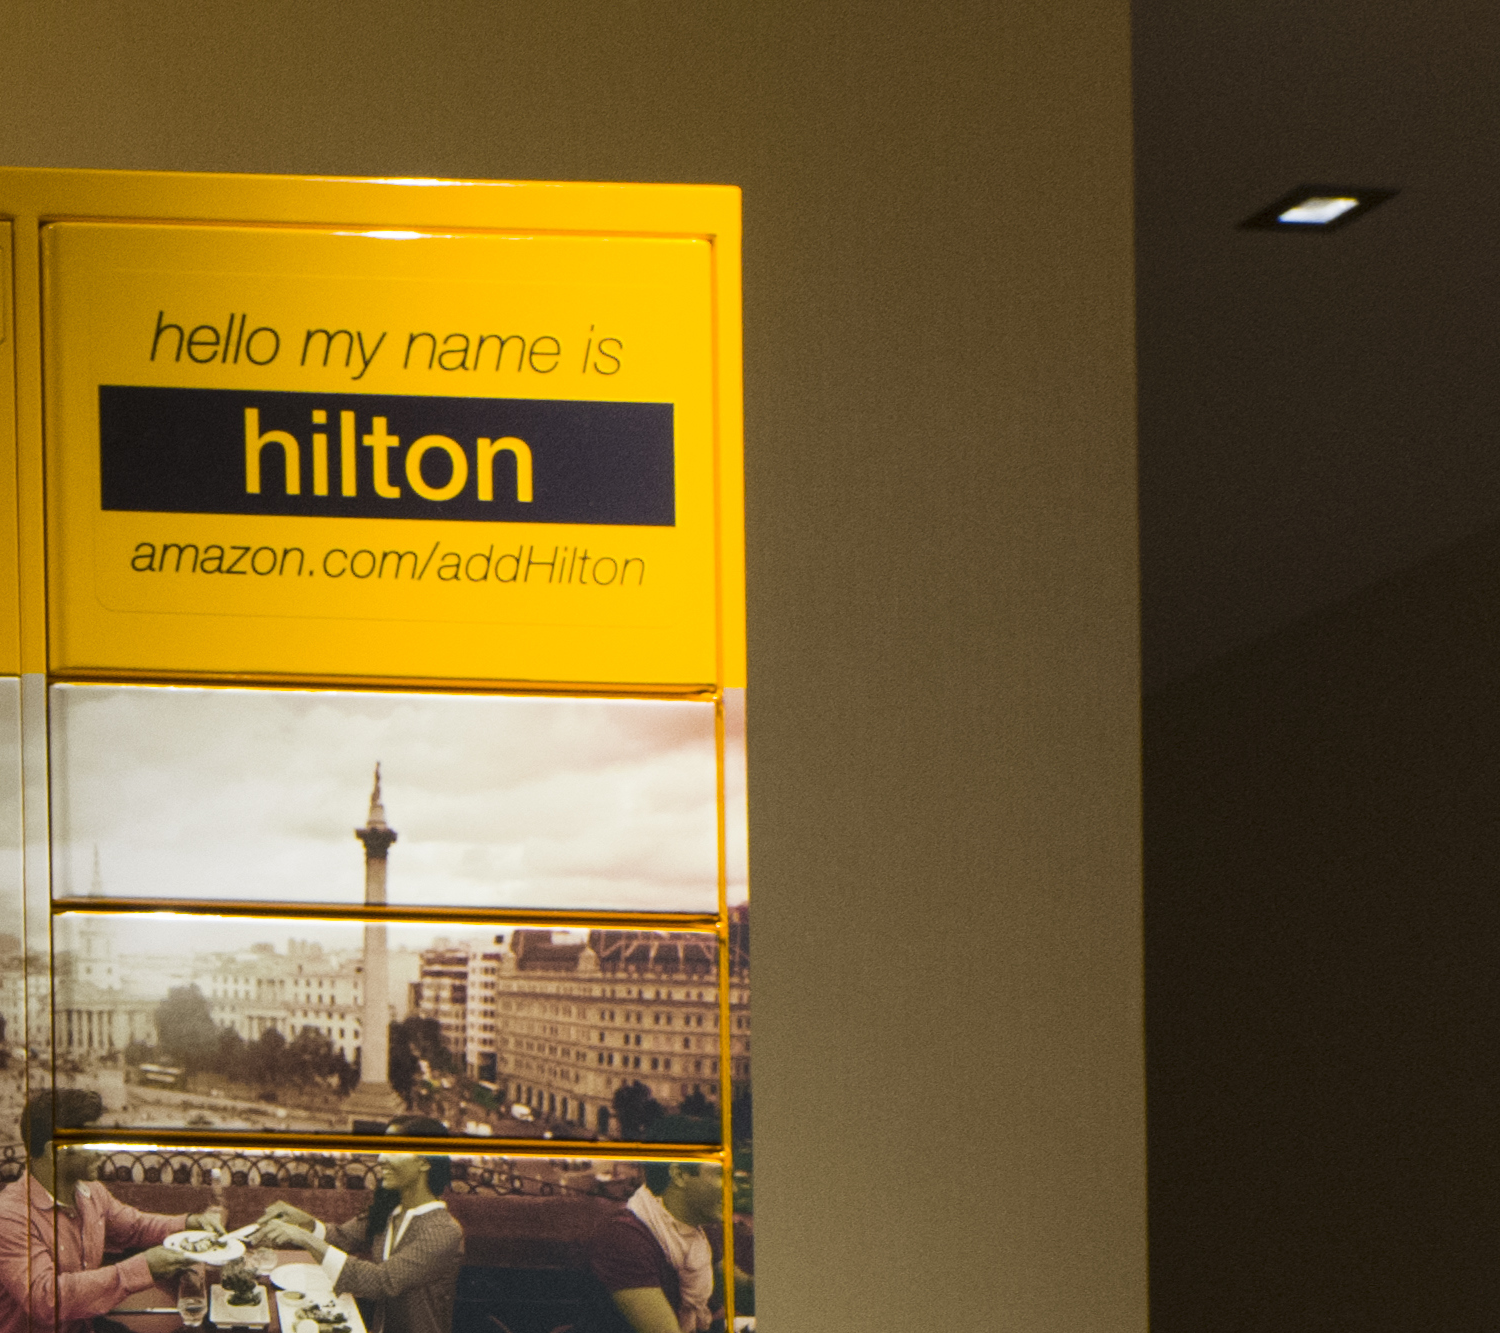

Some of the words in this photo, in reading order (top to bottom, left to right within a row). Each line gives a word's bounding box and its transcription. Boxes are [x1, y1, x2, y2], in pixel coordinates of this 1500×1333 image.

[149, 311, 281, 366] hello
[300, 327, 387, 380] my
[403, 330, 562, 374] name
[583, 324, 625, 376] is
[244, 407, 534, 503] hilton
[130, 540, 647, 586] amazon.com/addHilton
